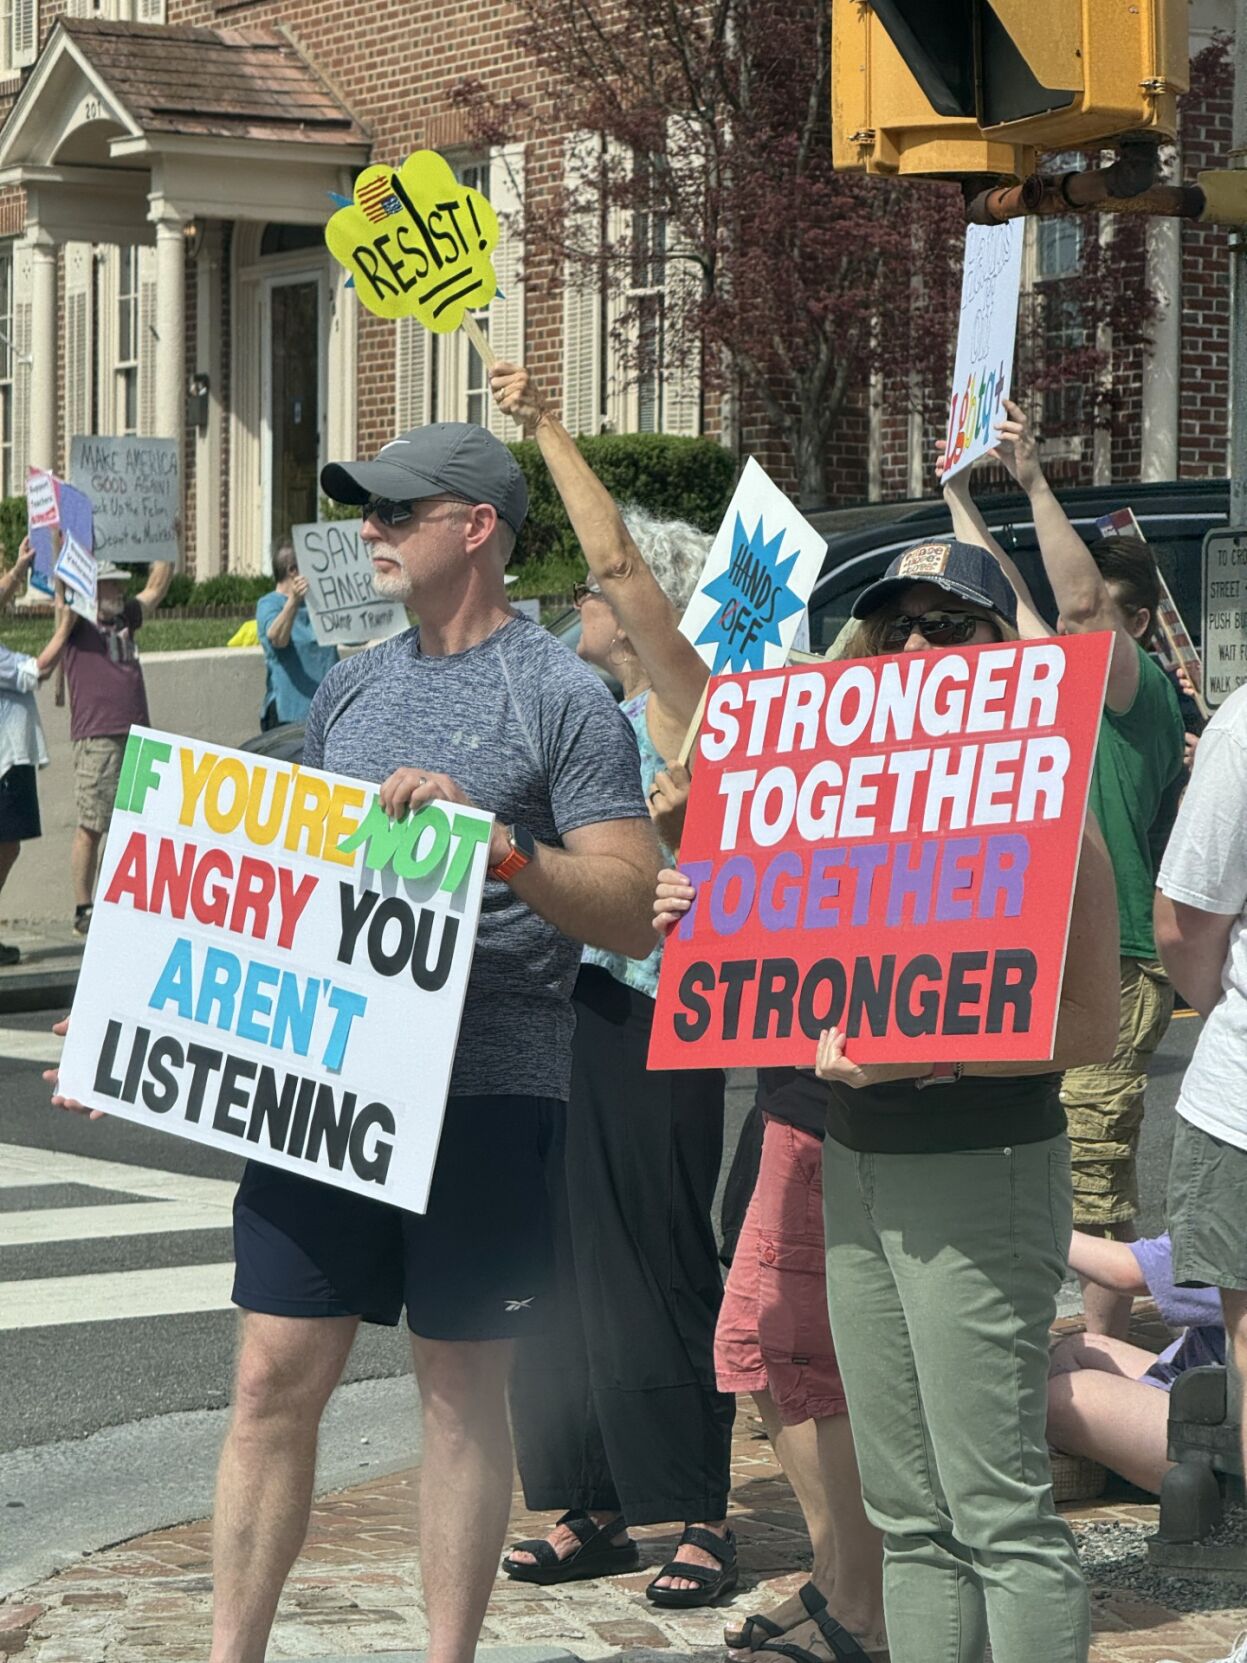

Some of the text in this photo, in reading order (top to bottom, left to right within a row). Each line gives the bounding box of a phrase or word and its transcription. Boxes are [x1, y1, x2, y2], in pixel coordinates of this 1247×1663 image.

[352, 173, 488, 301] RESIST!
[80, 443, 178, 477] MAKE AMERICA
[92, 474, 128, 495] GOOD
[728, 543, 783, 624] HANDS
[1210, 580, 1240, 598] STREET
[1218, 549, 1227, 566] TO
[719, 598, 763, 655] OFF
[1209, 611, 1231, 630] PUSH
[1218, 644, 1236, 661] WAIT
[700, 644, 1066, 762] STRONGER
[1209, 676, 1231, 693] WALK
[116, 735, 490, 893] IF YOU'RE NOT
[719, 736, 1071, 850] TOGETHER
[104, 832, 460, 991] ANGRY YOU
[677, 834, 1030, 941] TOGETHER
[148, 938, 368, 1074] AREN'T
[673, 949, 1038, 1044] STRONGER
[93, 1019, 395, 1185] LISTENING
